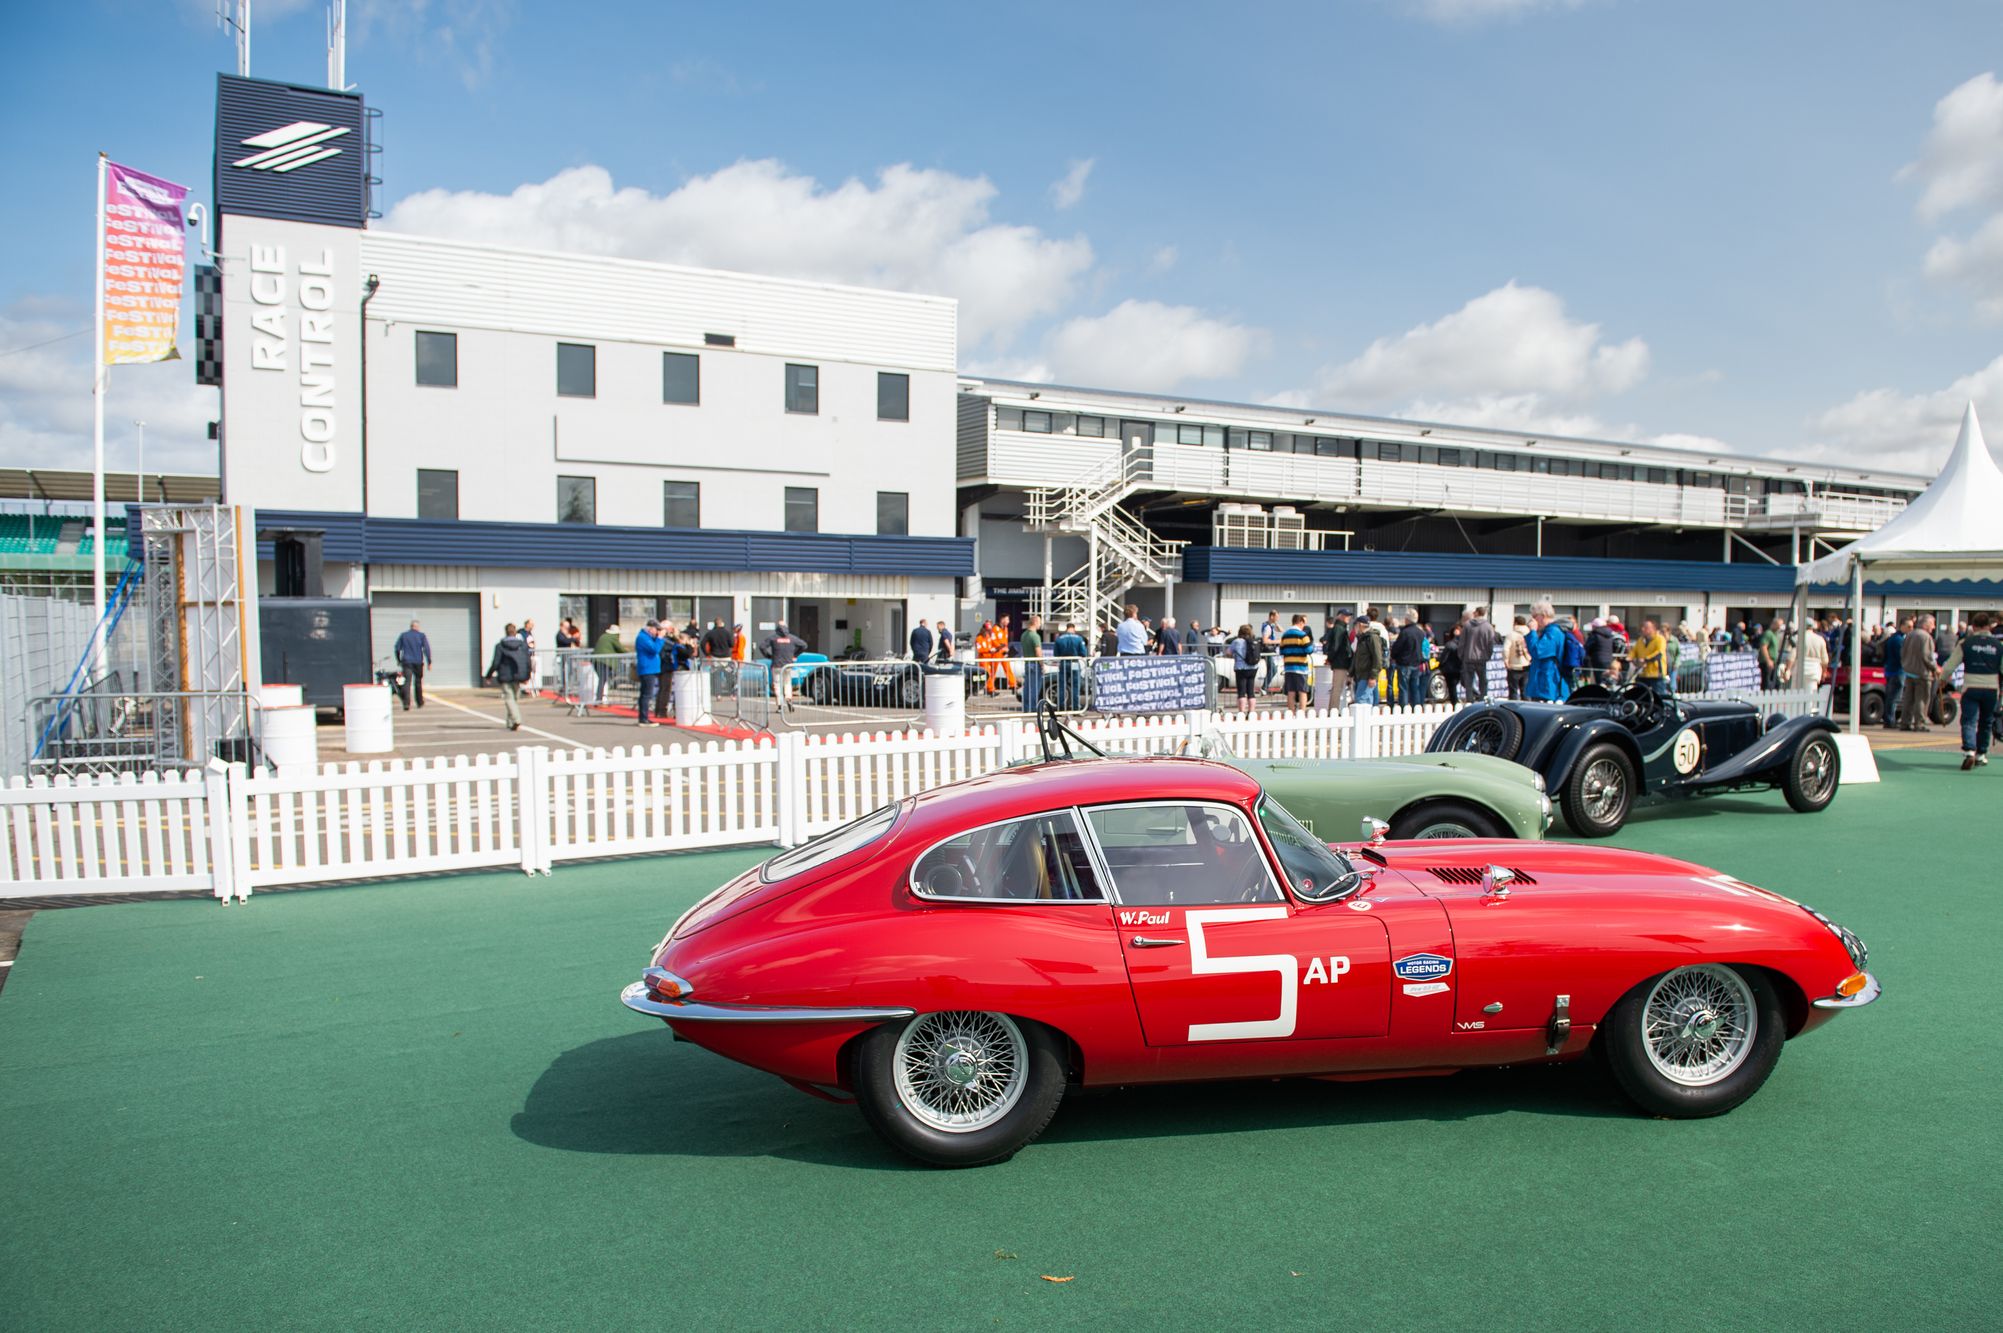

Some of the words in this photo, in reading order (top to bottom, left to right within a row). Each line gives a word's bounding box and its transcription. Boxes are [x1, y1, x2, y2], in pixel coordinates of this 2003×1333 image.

[251, 243, 286, 371] RACE
[299, 247, 335, 473] CONTROL
[1679, 743, 1695, 766] 50
[1119, 910, 1171, 926] W.Paul
[1185, 906, 1299, 1042] 5
[1303, 955, 1351, 985] AP
[1400, 964, 1447, 974] LEGENDS
